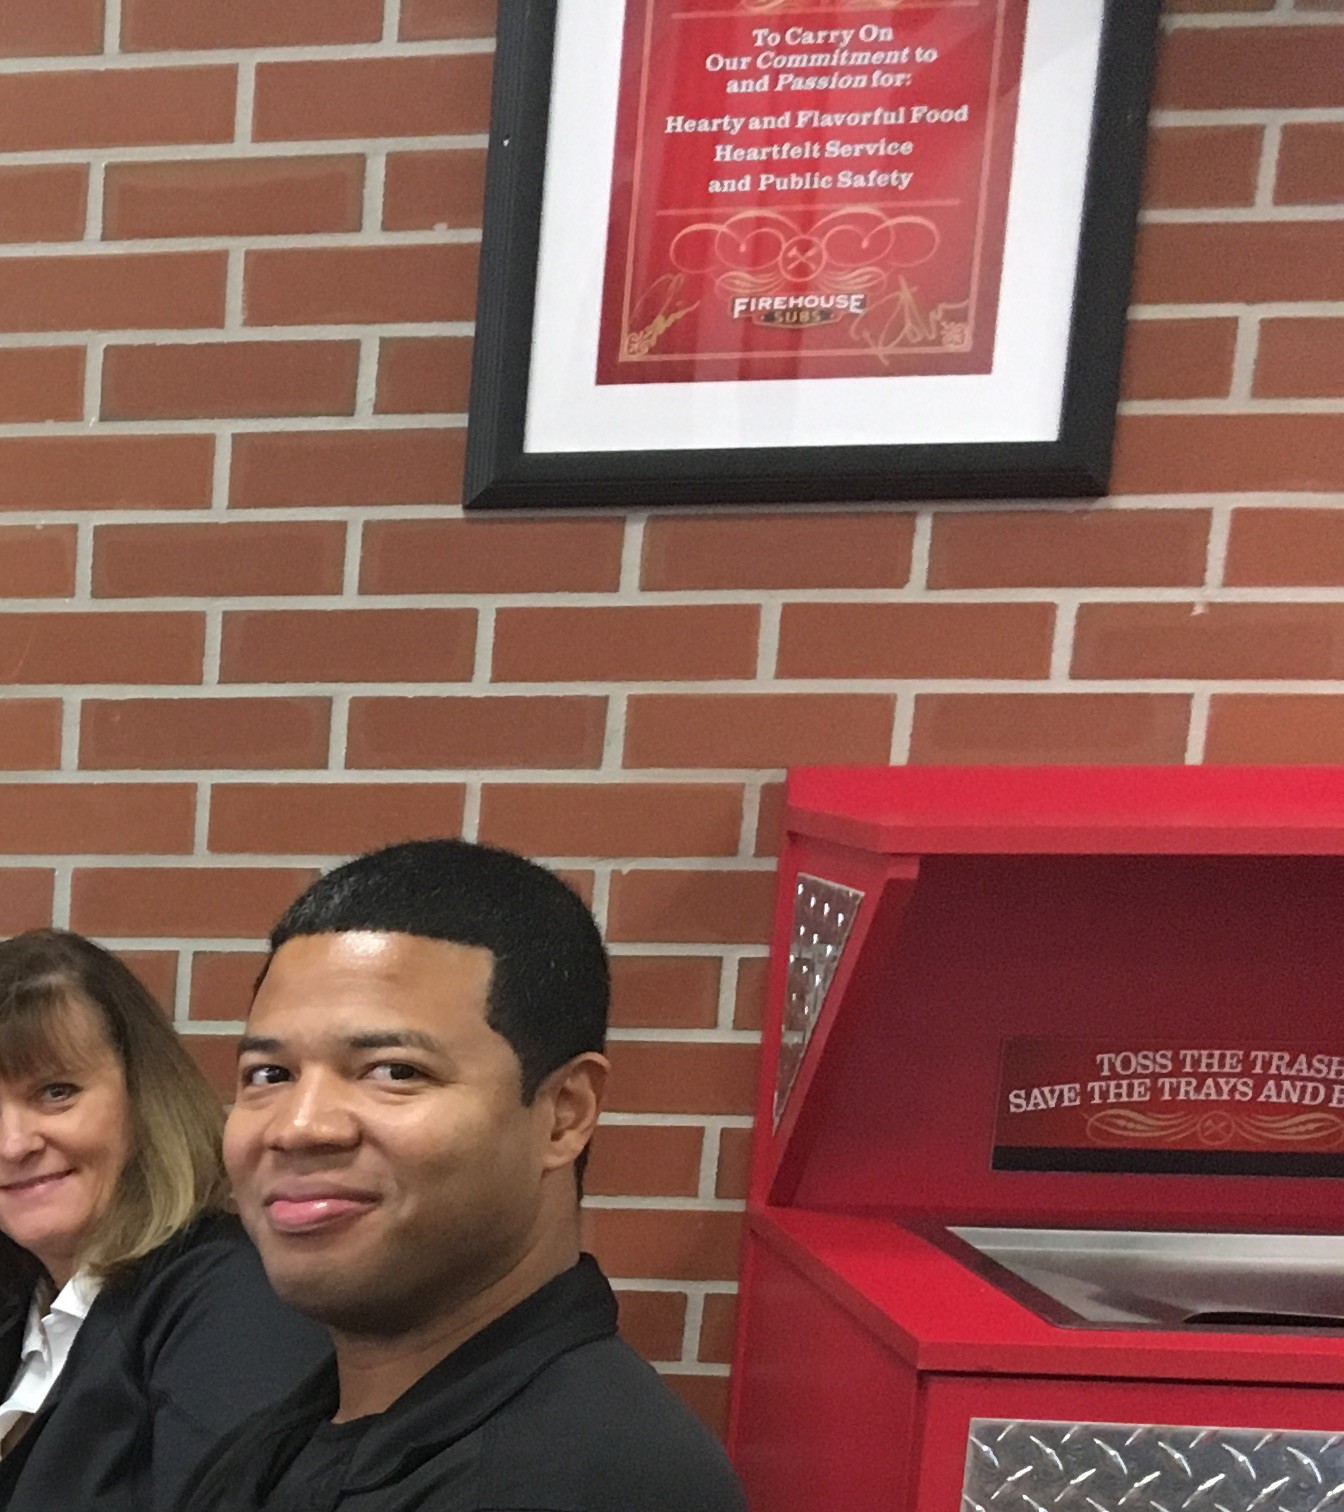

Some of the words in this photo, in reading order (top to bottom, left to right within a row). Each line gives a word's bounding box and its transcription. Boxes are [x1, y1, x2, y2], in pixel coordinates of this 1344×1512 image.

[752, 28, 780, 47] To
[784, 26, 854, 49] Carry
[859, 24, 894, 43] On
[705, 53, 752, 72] Our
[755, 47, 910, 70] Commitment
[914, 46, 939, 63] to
[726, 75, 769, 93] and
[773, 72, 868, 91] Passion
[870, 69, 913, 88] for:
[664, 115, 745, 135] Hearty
[748, 111, 791, 130] and
[795, 106, 905, 129] Flavorful
[910, 104, 969, 124] Food
[713, 140, 820, 162] Heartfelt
[825, 138, 914, 159] Service
[708, 174, 751, 193] and
[758, 172, 832, 191] Public
[837, 170, 914, 190] Safety
[733, 293, 865, 318] FIREHOUSE
[774, 310, 822, 323] SUBS
[1096, 1050, 1173, 1077] TOSS
[1180, 1050, 1244, 1074] THE
[1250, 1050, 1344, 1080] TRASH
[1008, 1083, 1081, 1114] SAVE
[1087, 1078, 1152, 1104] THE
[1157, 1077, 1254, 1102] TRAYS
[1256, 1080, 1326, 1106] AND
